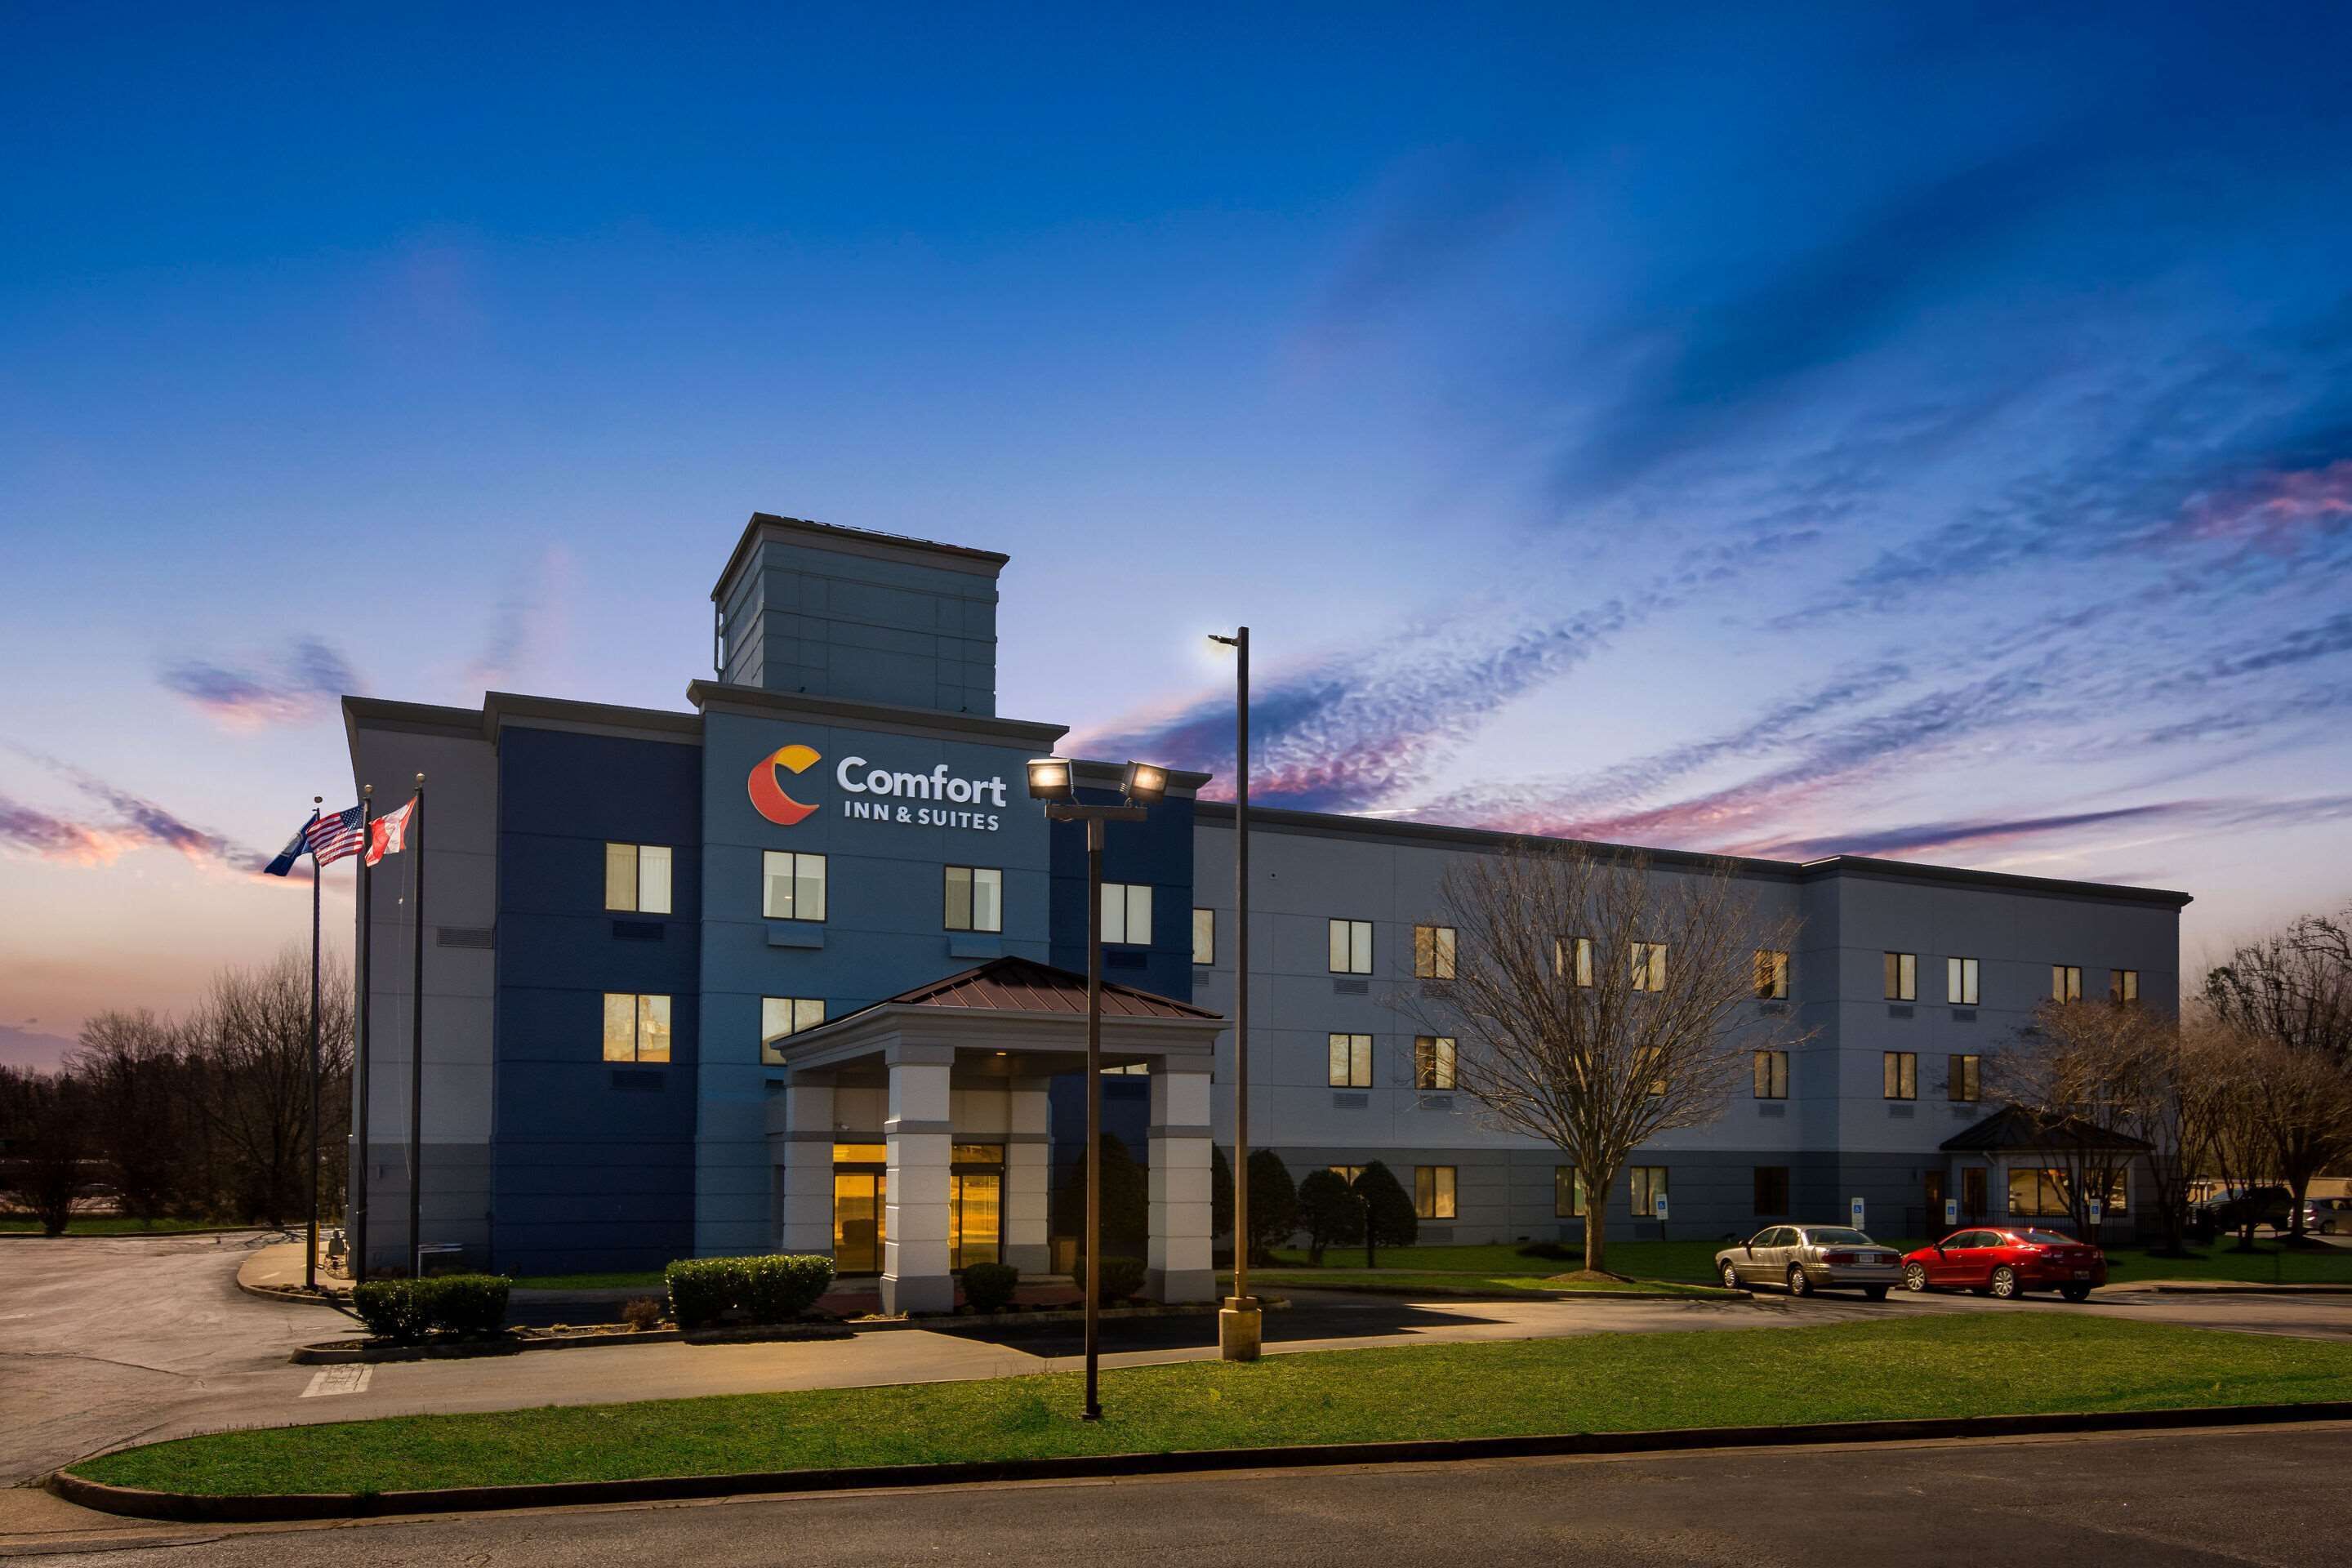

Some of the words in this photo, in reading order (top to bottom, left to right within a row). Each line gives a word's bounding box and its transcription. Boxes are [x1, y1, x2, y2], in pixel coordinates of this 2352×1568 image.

[836, 756, 1007, 807] Comfort
[844, 800, 889, 822] INN
[896, 806, 911, 823] &
[917, 808, 1000, 831] SUITES
